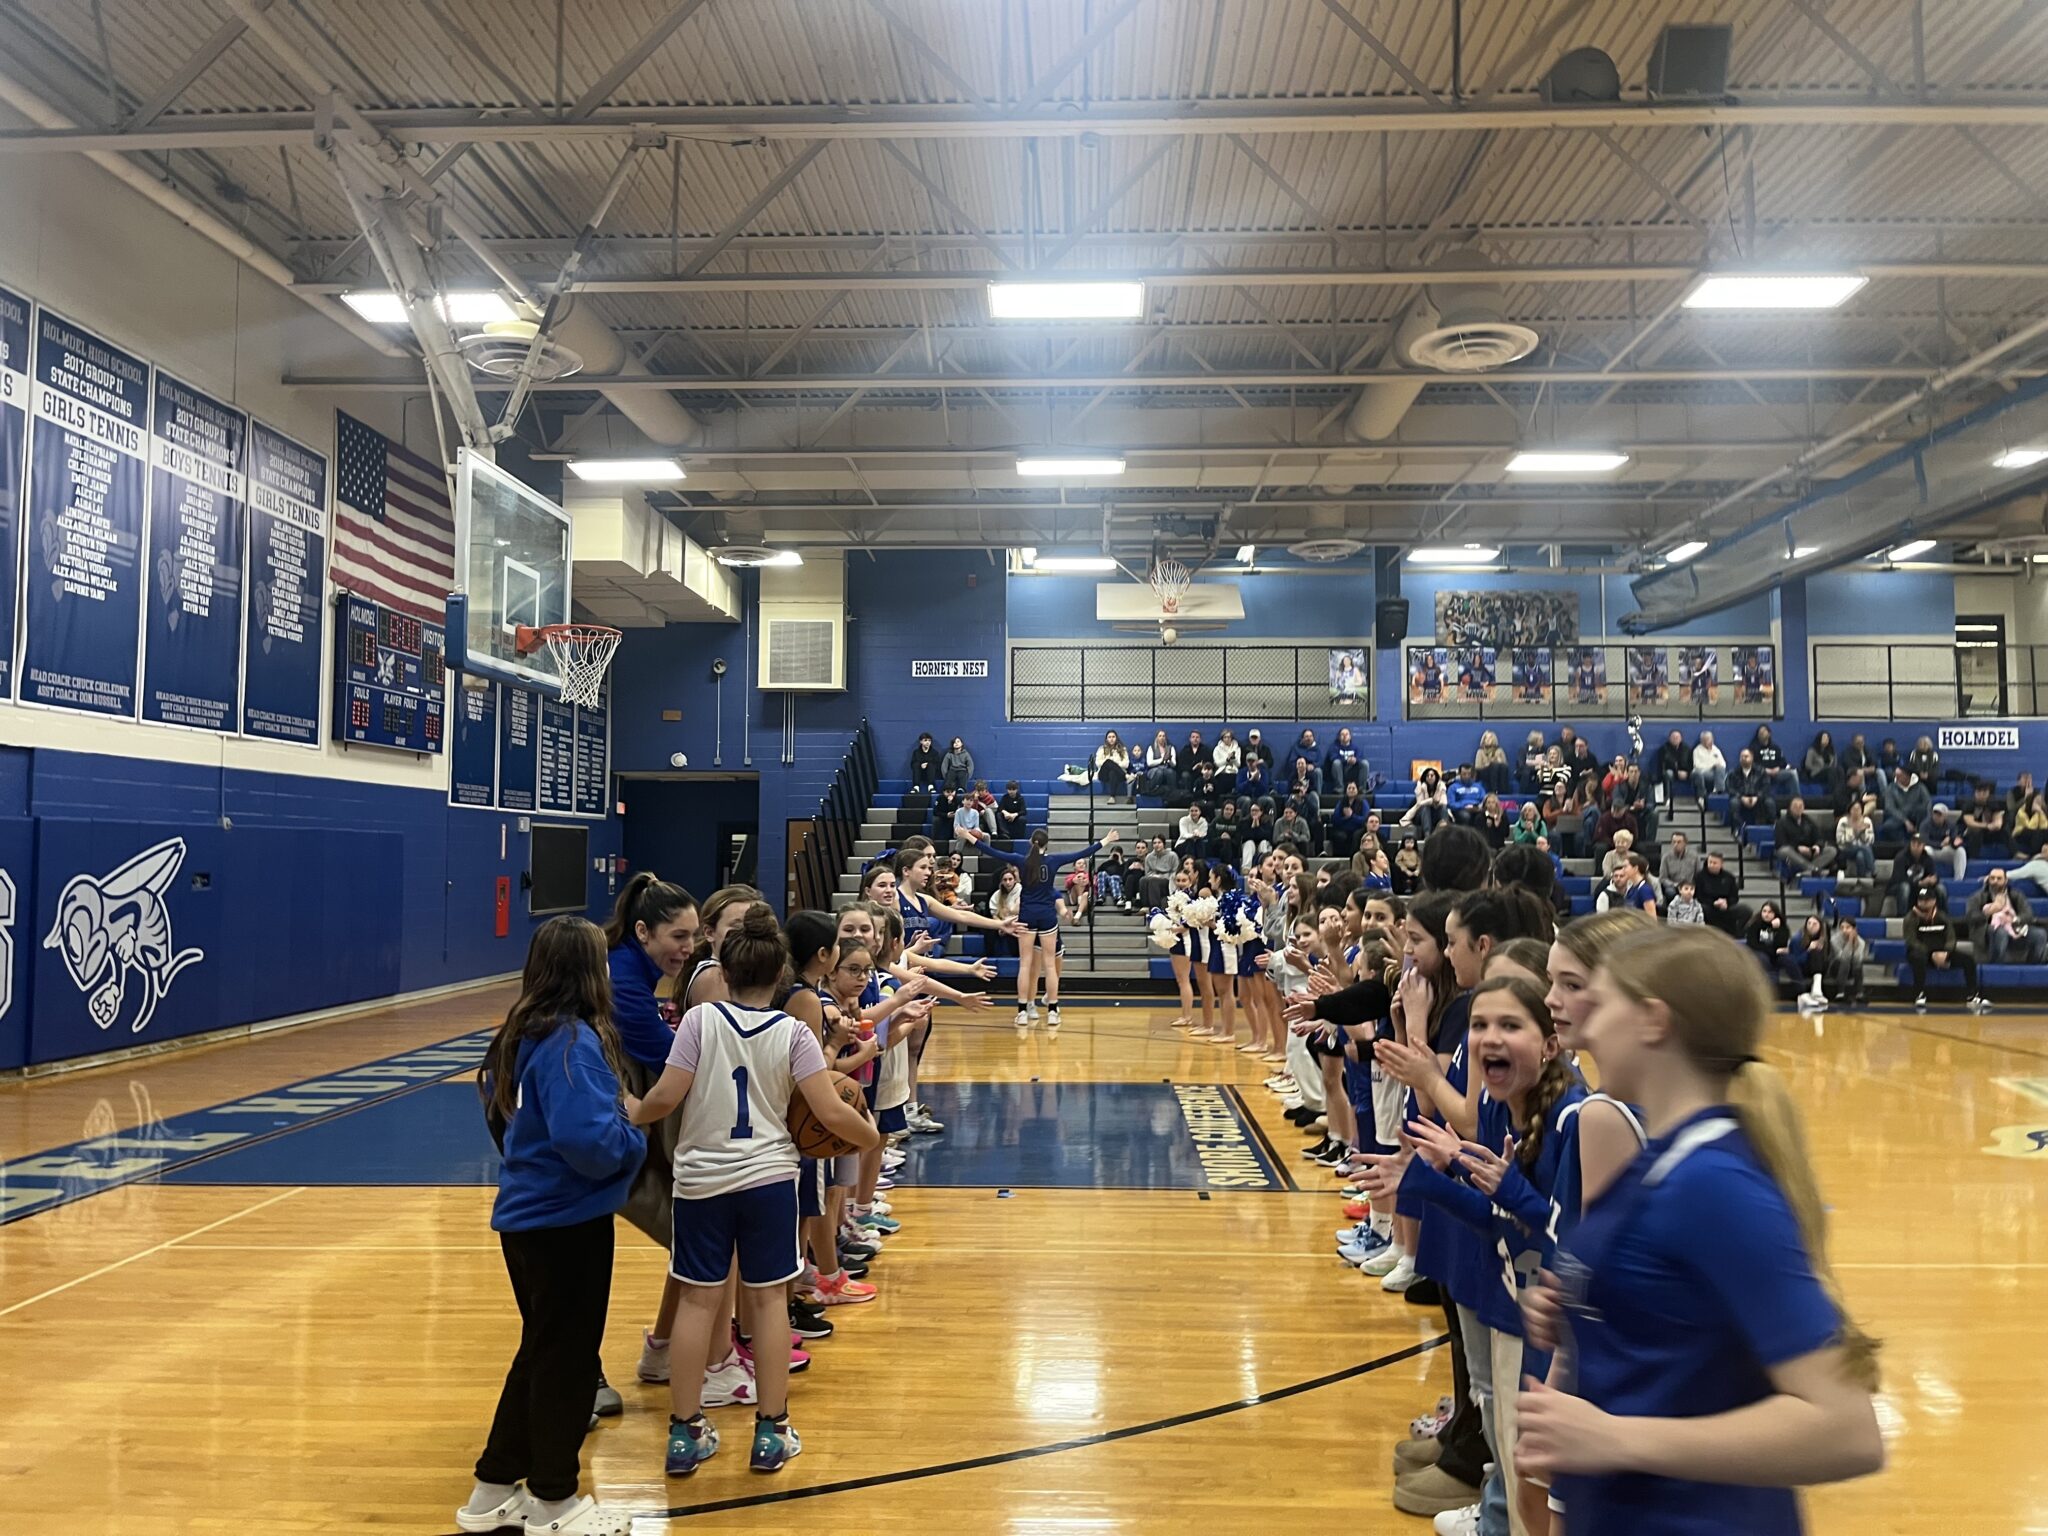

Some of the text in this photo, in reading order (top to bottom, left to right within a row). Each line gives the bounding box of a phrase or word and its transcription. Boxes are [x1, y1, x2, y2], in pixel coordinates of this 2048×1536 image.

[44, 322, 86, 357] HOLMDEL
[88, 344, 110, 368] HIGH
[111, 356, 142, 385] SCHOOL
[64, 352, 124, 394] 2017 GROUP II
[51, 366, 132, 417] STATE CHAMPIONS
[160, 380, 195, 410] HOLMDEL
[43, 391, 138, 450] GIRLS TENNIS
[177, 408, 193, 428] 2017
[194, 417, 219, 439] GROUP
[166, 421, 235, 465] STATE CHAMPIONS
[162, 444, 191, 474] BOYS
[194, 458, 238, 493] TENNIS
[284, 462, 304, 481] GROUP
[93, 491, 103, 503] LAI
[260, 466, 315, 502] STATE CHAMPIONS
[92, 503, 102, 514] LAI
[256, 486, 320, 530] GIRLS TENNIS
[350, 604, 375, 627] HOLMDEL
[30, 668, 46, 683] HEAD
[72, 676, 94, 691] CHUCK
[915, 662, 985, 675] HORNET'S NEST
[37, 684, 54, 698] ASST
[80, 691, 93, 704] DON
[354, 686, 369, 700] FOULS
[384, 692, 417, 710] PLAYER FOULS
[427, 702, 440, 714] FOULS
[1942, 732, 2015, 746] HOLMDEL
[732, 1066, 753, 1139] 1
[1174, 1086, 1270, 1186] SHORE CONFERENCE
